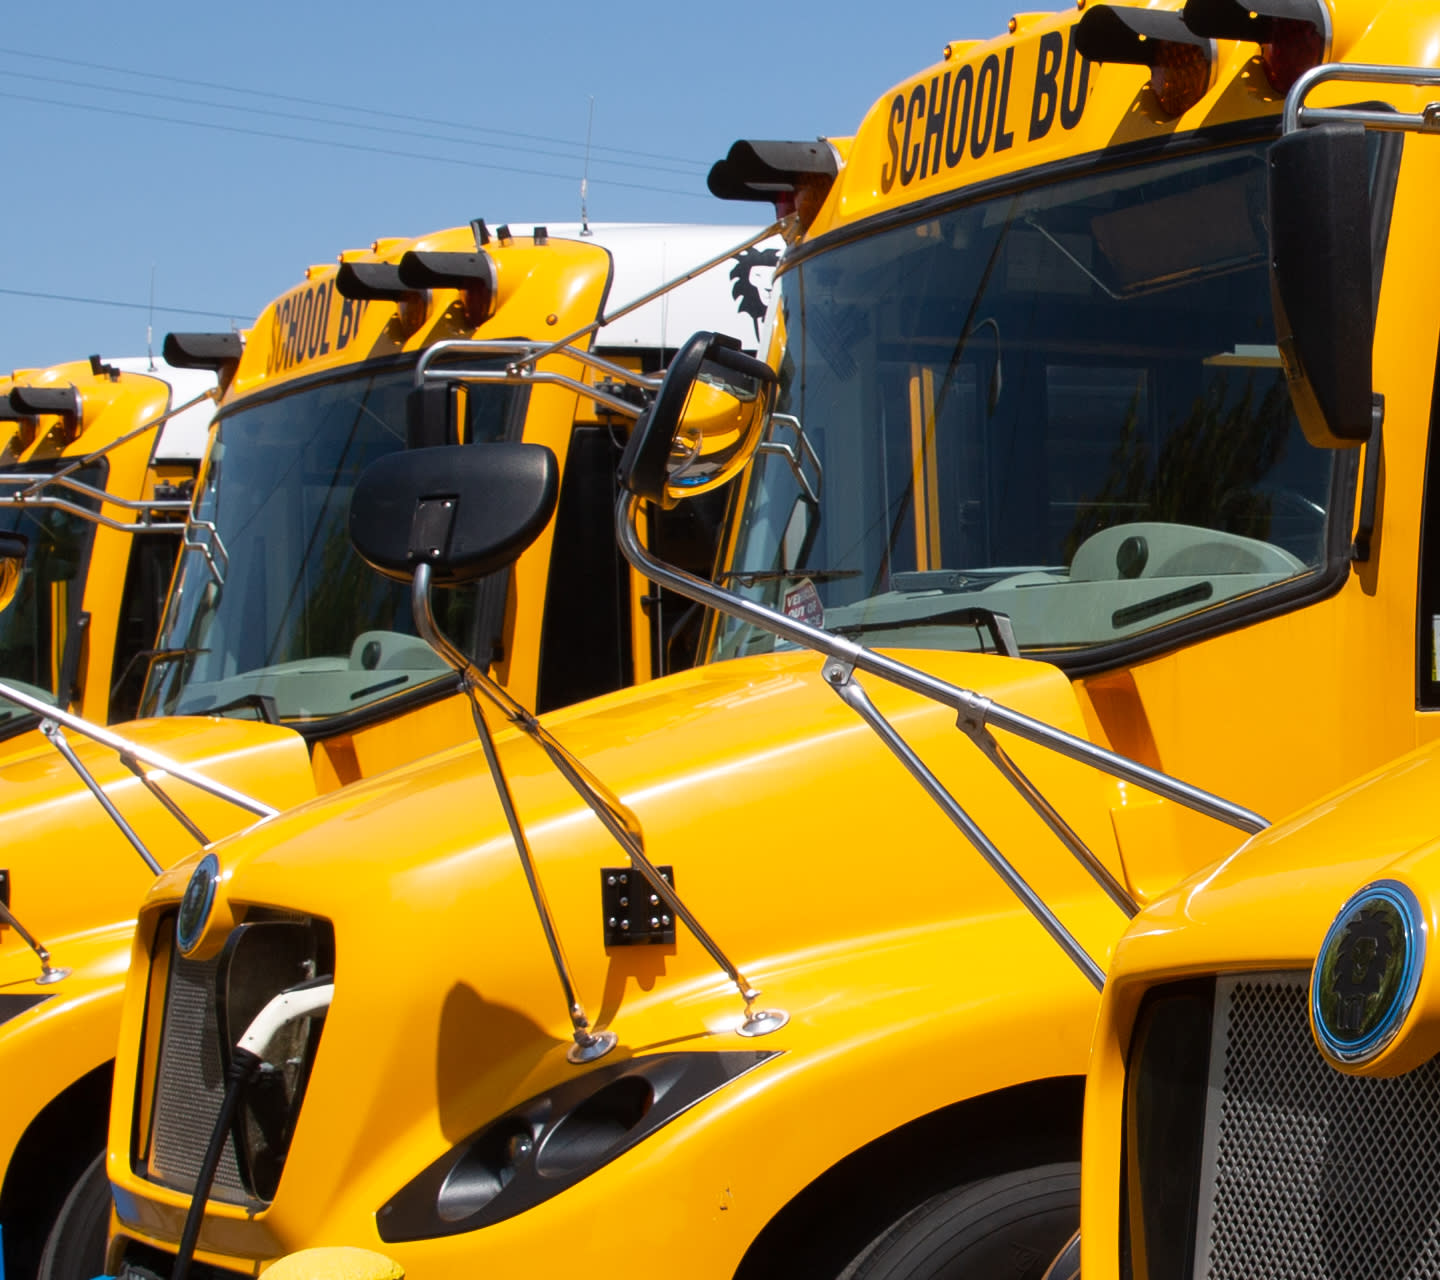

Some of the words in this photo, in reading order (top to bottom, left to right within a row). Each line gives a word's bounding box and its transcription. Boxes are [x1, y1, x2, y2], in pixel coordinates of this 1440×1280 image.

[881, 45, 1016, 196] SCHOOL
[1027, 22, 1094, 143] BU
[266, 277, 334, 377] SCHOOL
